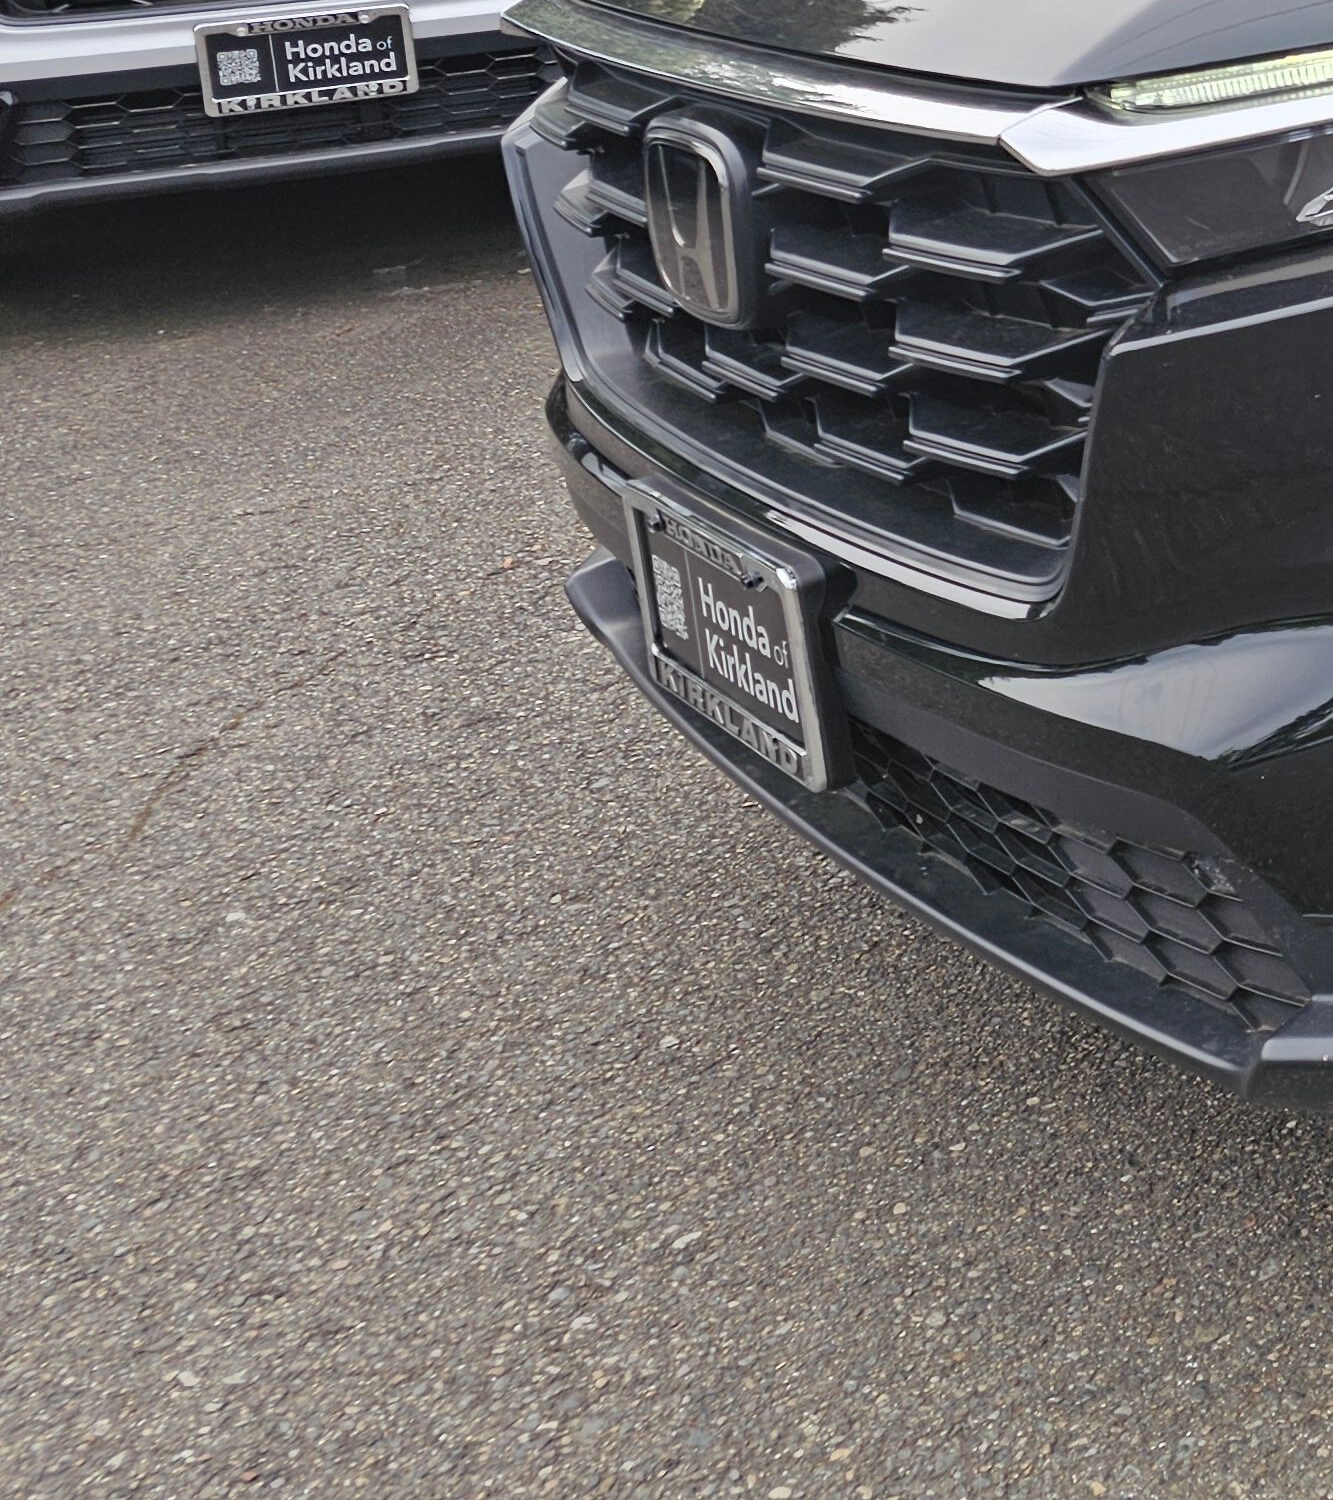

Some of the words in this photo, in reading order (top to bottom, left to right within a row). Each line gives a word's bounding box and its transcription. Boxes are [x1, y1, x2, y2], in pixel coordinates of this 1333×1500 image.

[251, 12, 356, 35] HONDA
[284, 33, 373, 60] Honda
[376, 36, 393, 51] of
[287, 51, 397, 83] Kirkland
[220, 81, 405, 114] KIRKLAND
[661, 512, 743, 576] HONDA
[697, 577, 772, 659] Honda
[773, 640, 790, 669] of
[704, 627, 800, 724] Kirkland
[660, 663, 799, 775] KIRKLAND
